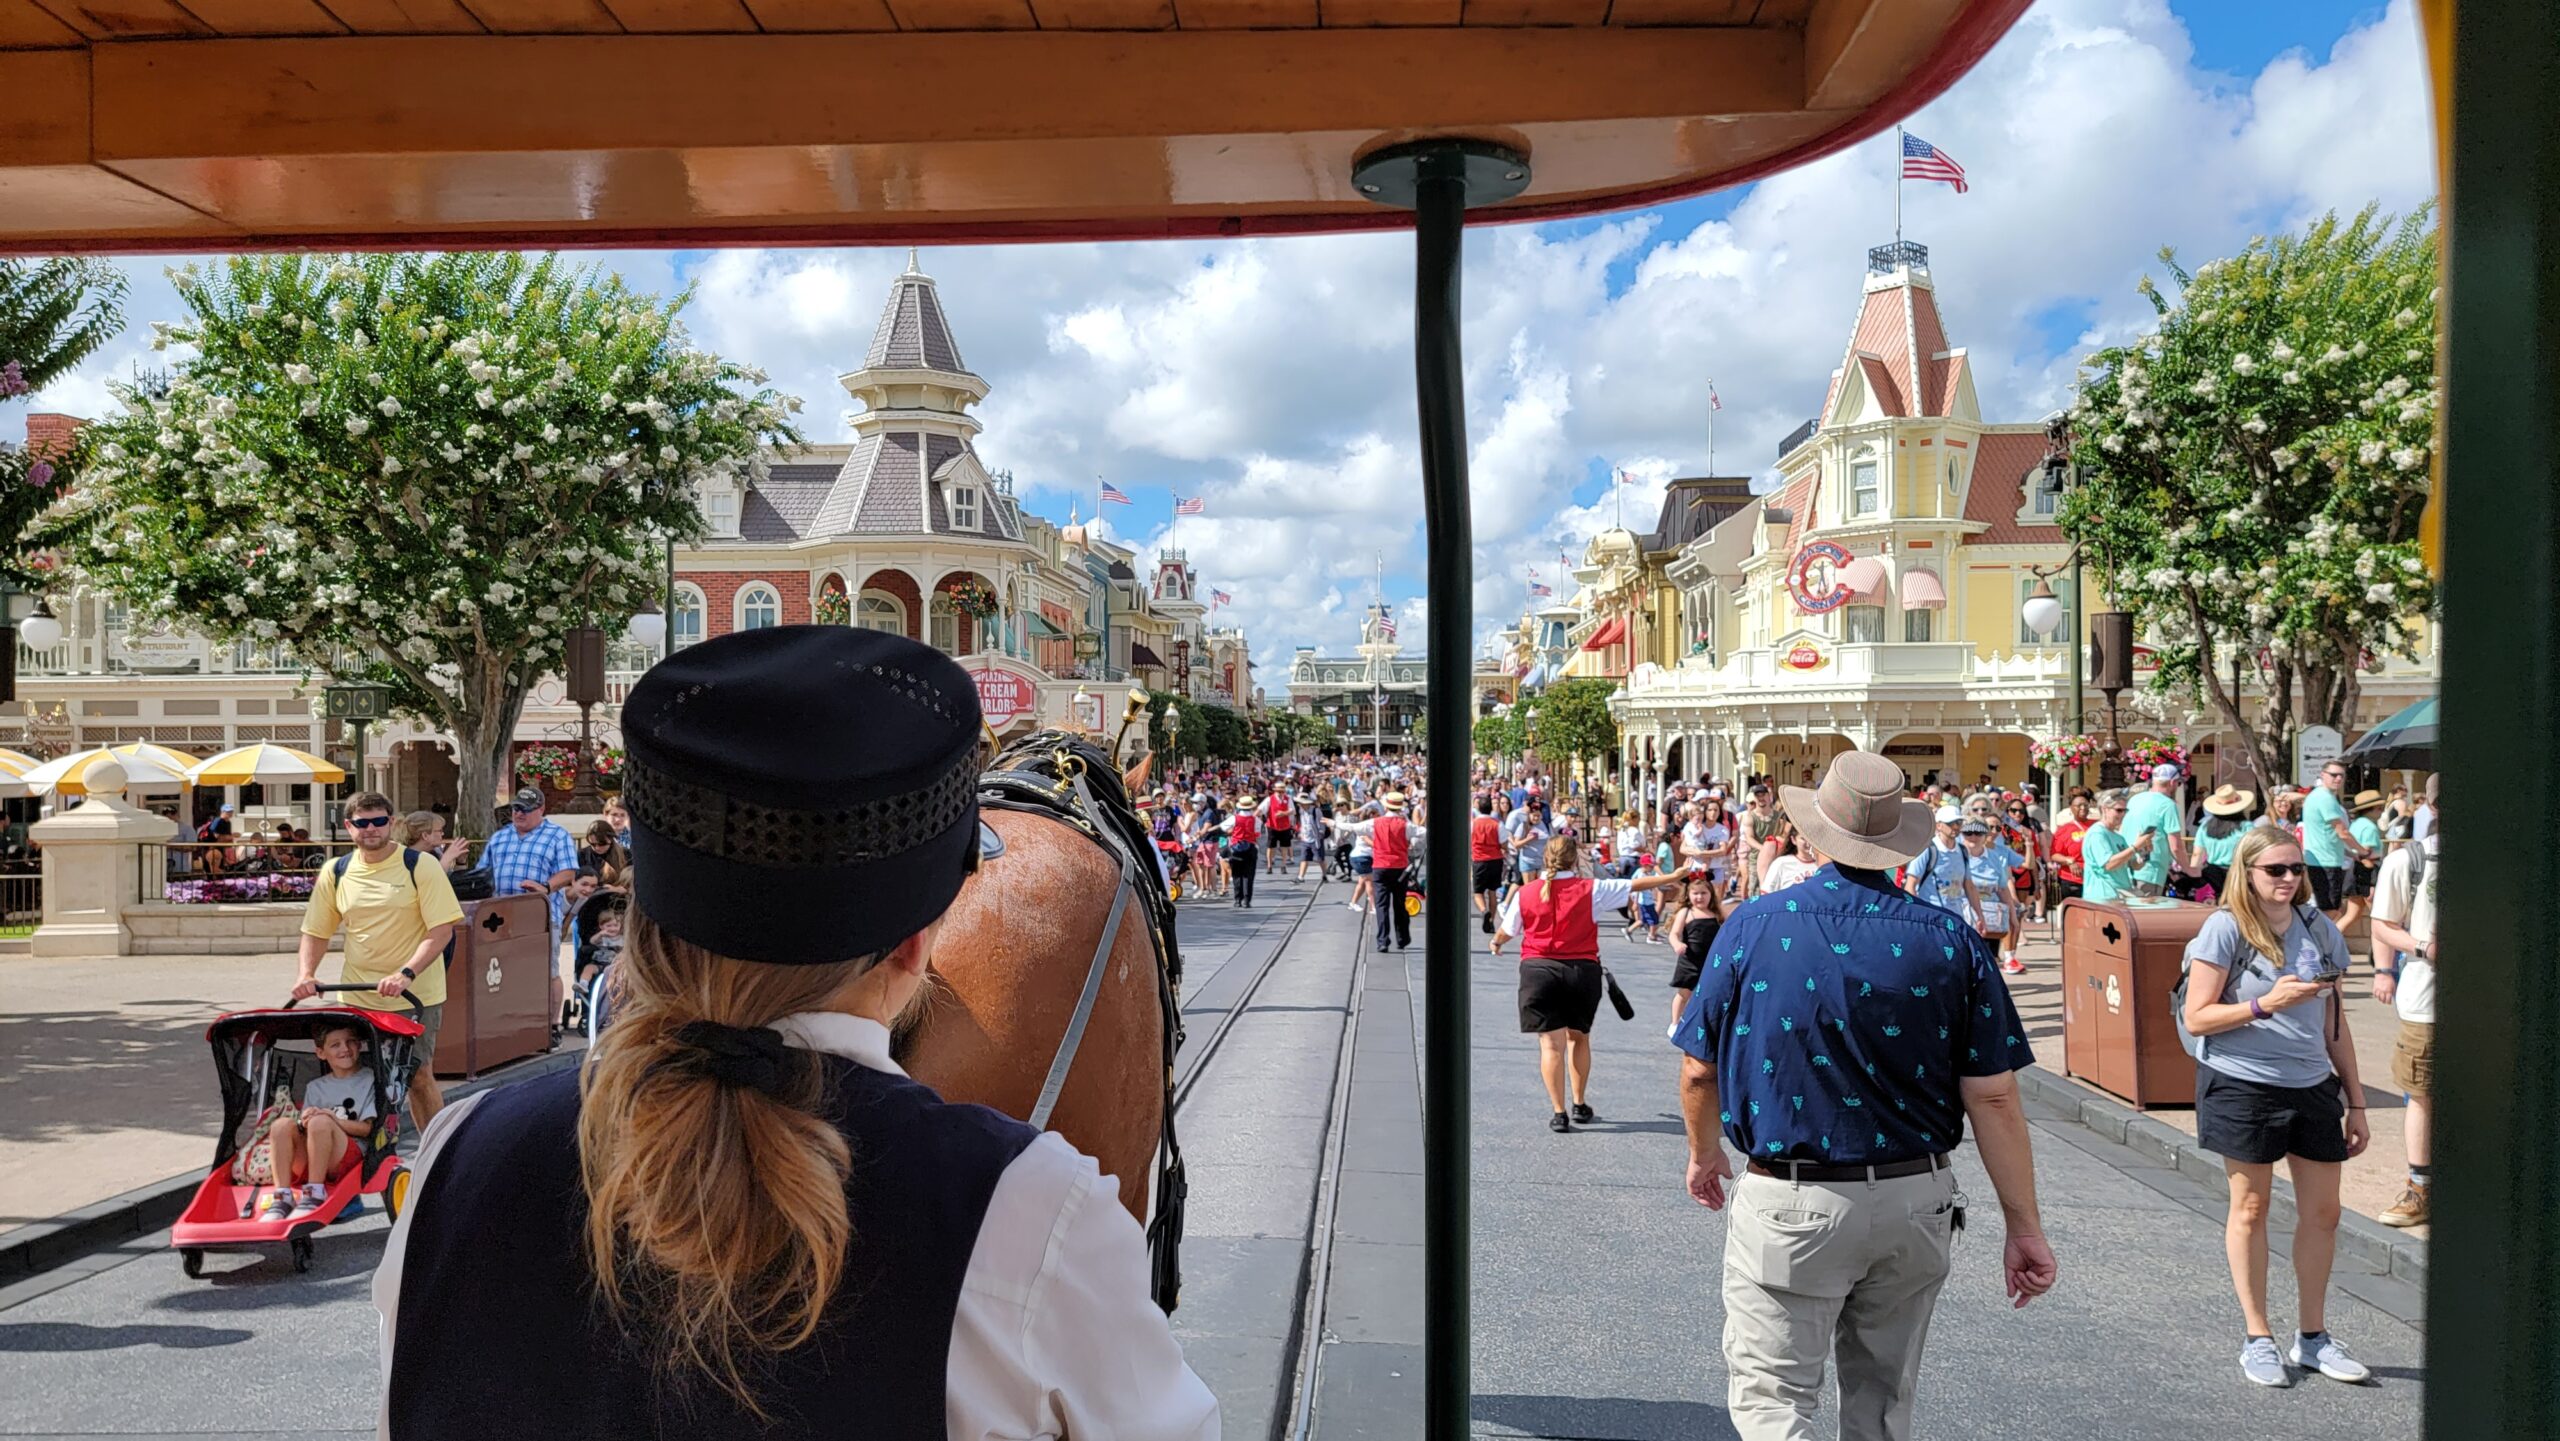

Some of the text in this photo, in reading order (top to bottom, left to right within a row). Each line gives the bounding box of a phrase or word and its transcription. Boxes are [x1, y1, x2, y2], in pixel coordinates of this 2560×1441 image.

[982, 671, 1003, 682] PLAZA
[984, 683, 1018, 698] CREAM
[980, 698, 1011, 713] ARLOR
